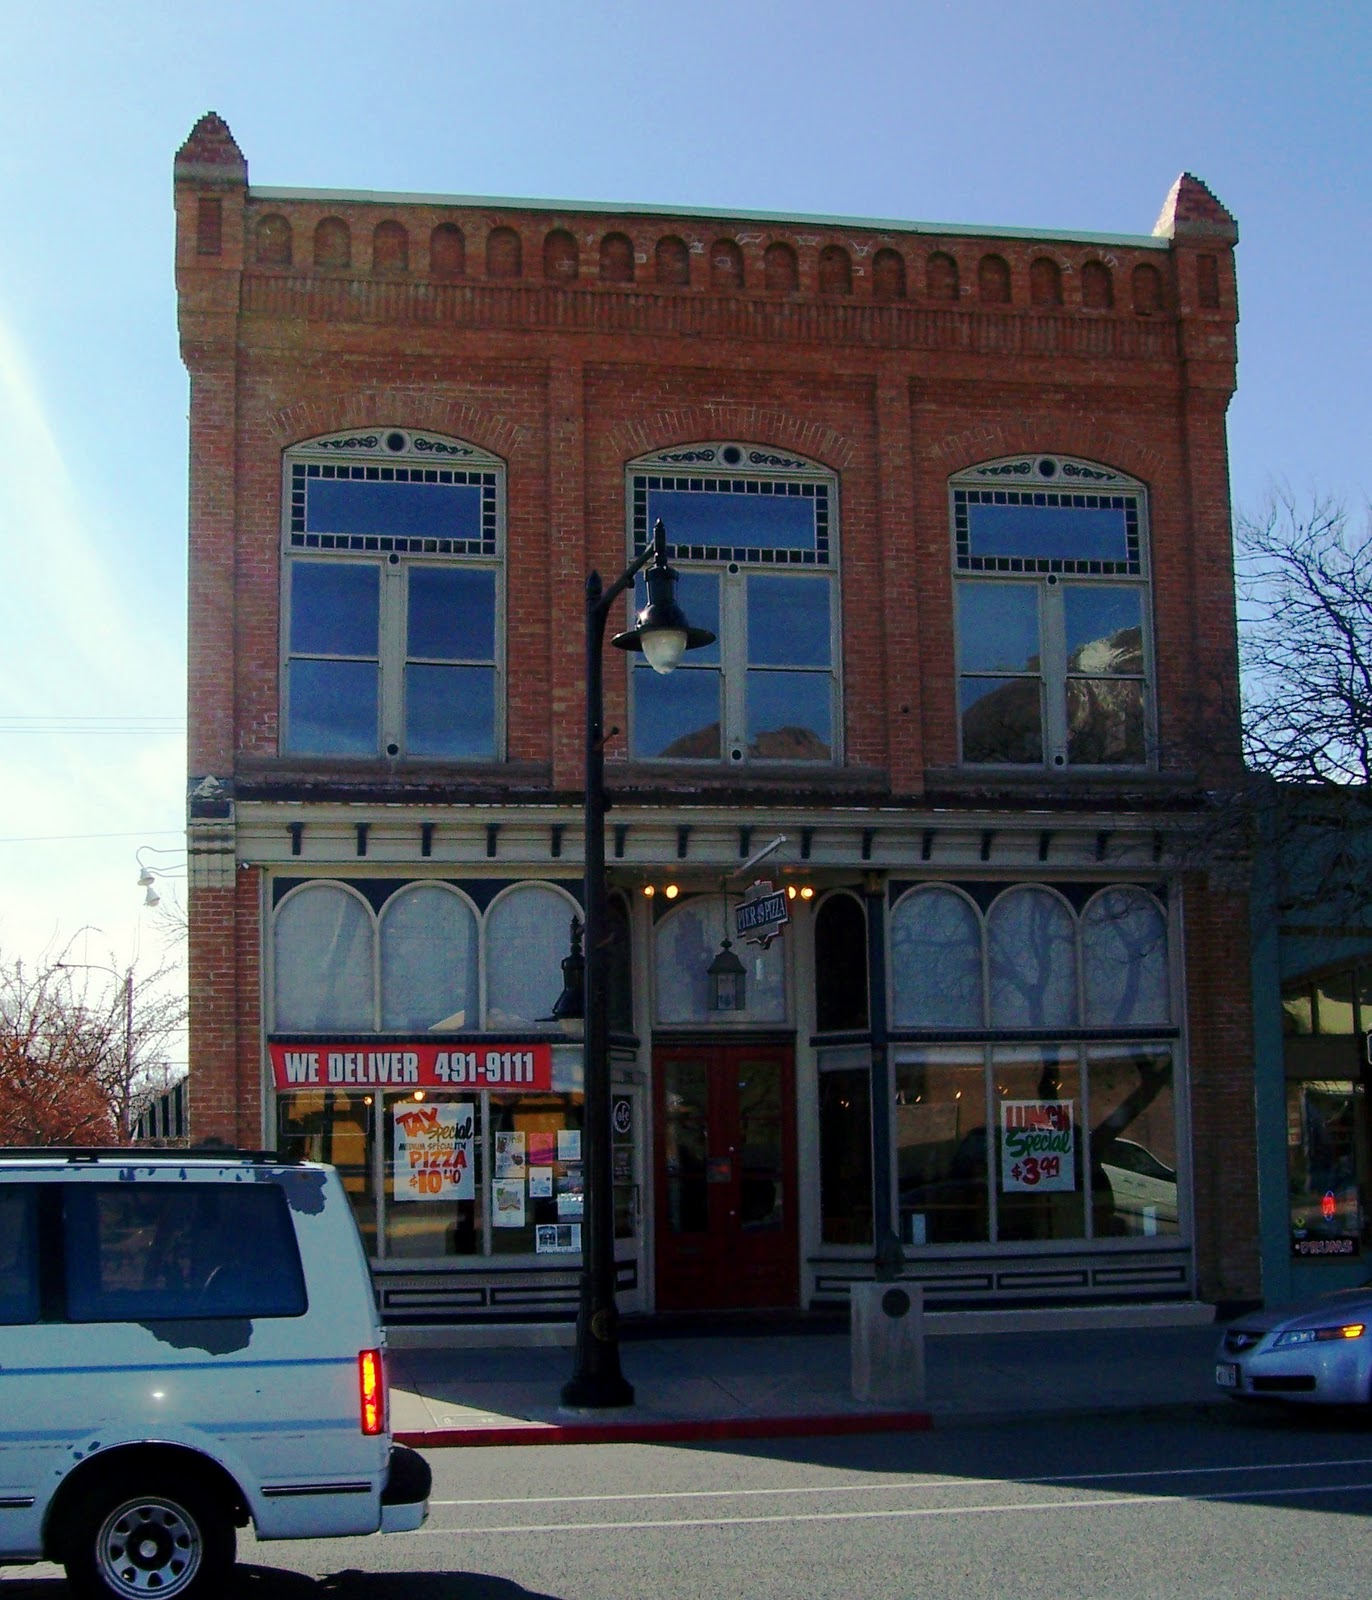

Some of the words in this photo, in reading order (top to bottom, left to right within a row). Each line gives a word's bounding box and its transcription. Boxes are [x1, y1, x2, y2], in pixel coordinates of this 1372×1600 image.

[764, 897, 786, 921] PIZZA
[284, 1052, 319, 1083] WE
[328, 1052, 419, 1083] DELIVER
[434, 1051, 534, 1082] 491-9111
[395, 1107, 442, 1137] TAX
[1006, 1104, 1071, 1132] LUNCH
[1005, 1126, 1072, 1157] Special
[409, 1150, 467, 1168] PIZZA
